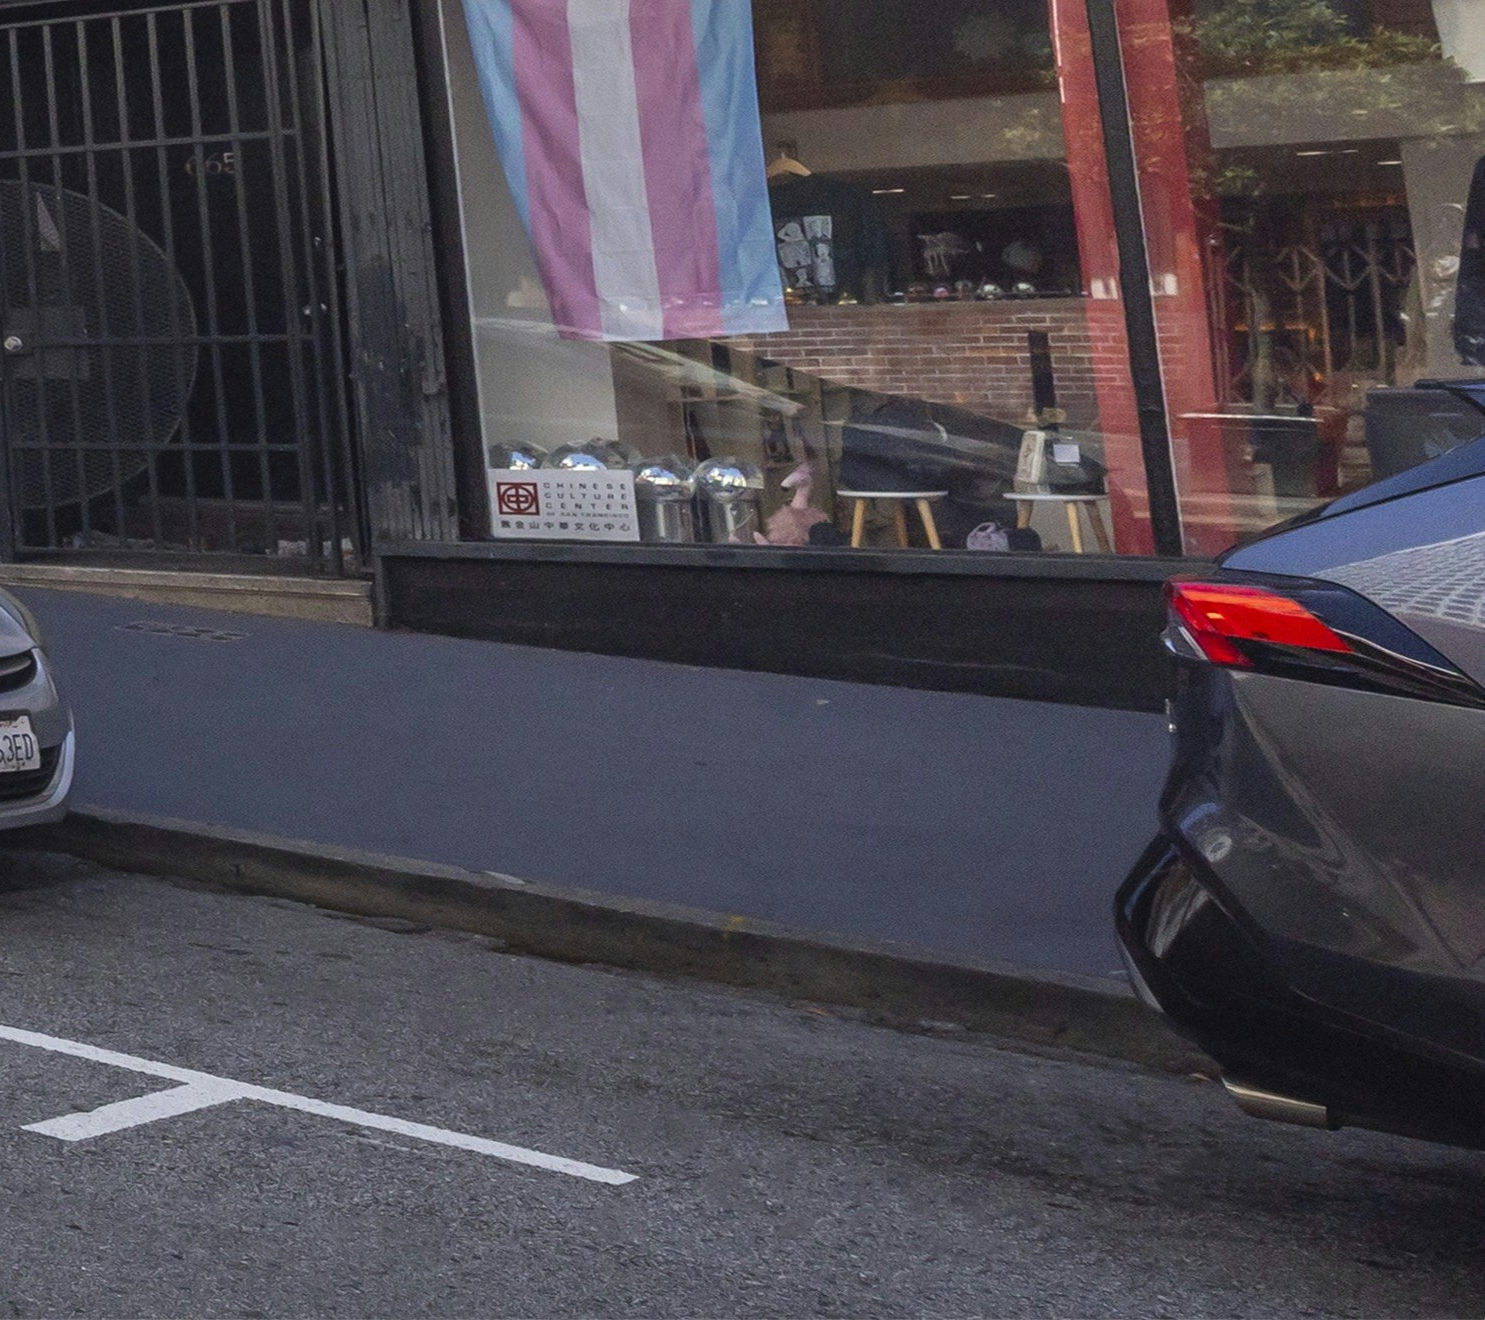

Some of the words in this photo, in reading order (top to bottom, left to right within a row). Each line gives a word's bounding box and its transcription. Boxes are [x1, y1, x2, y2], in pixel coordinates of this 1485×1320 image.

[542, 482, 627, 491] CHINESE
[543, 492, 628, 501] CULTURE
[544, 502, 629, 511] CENTER
